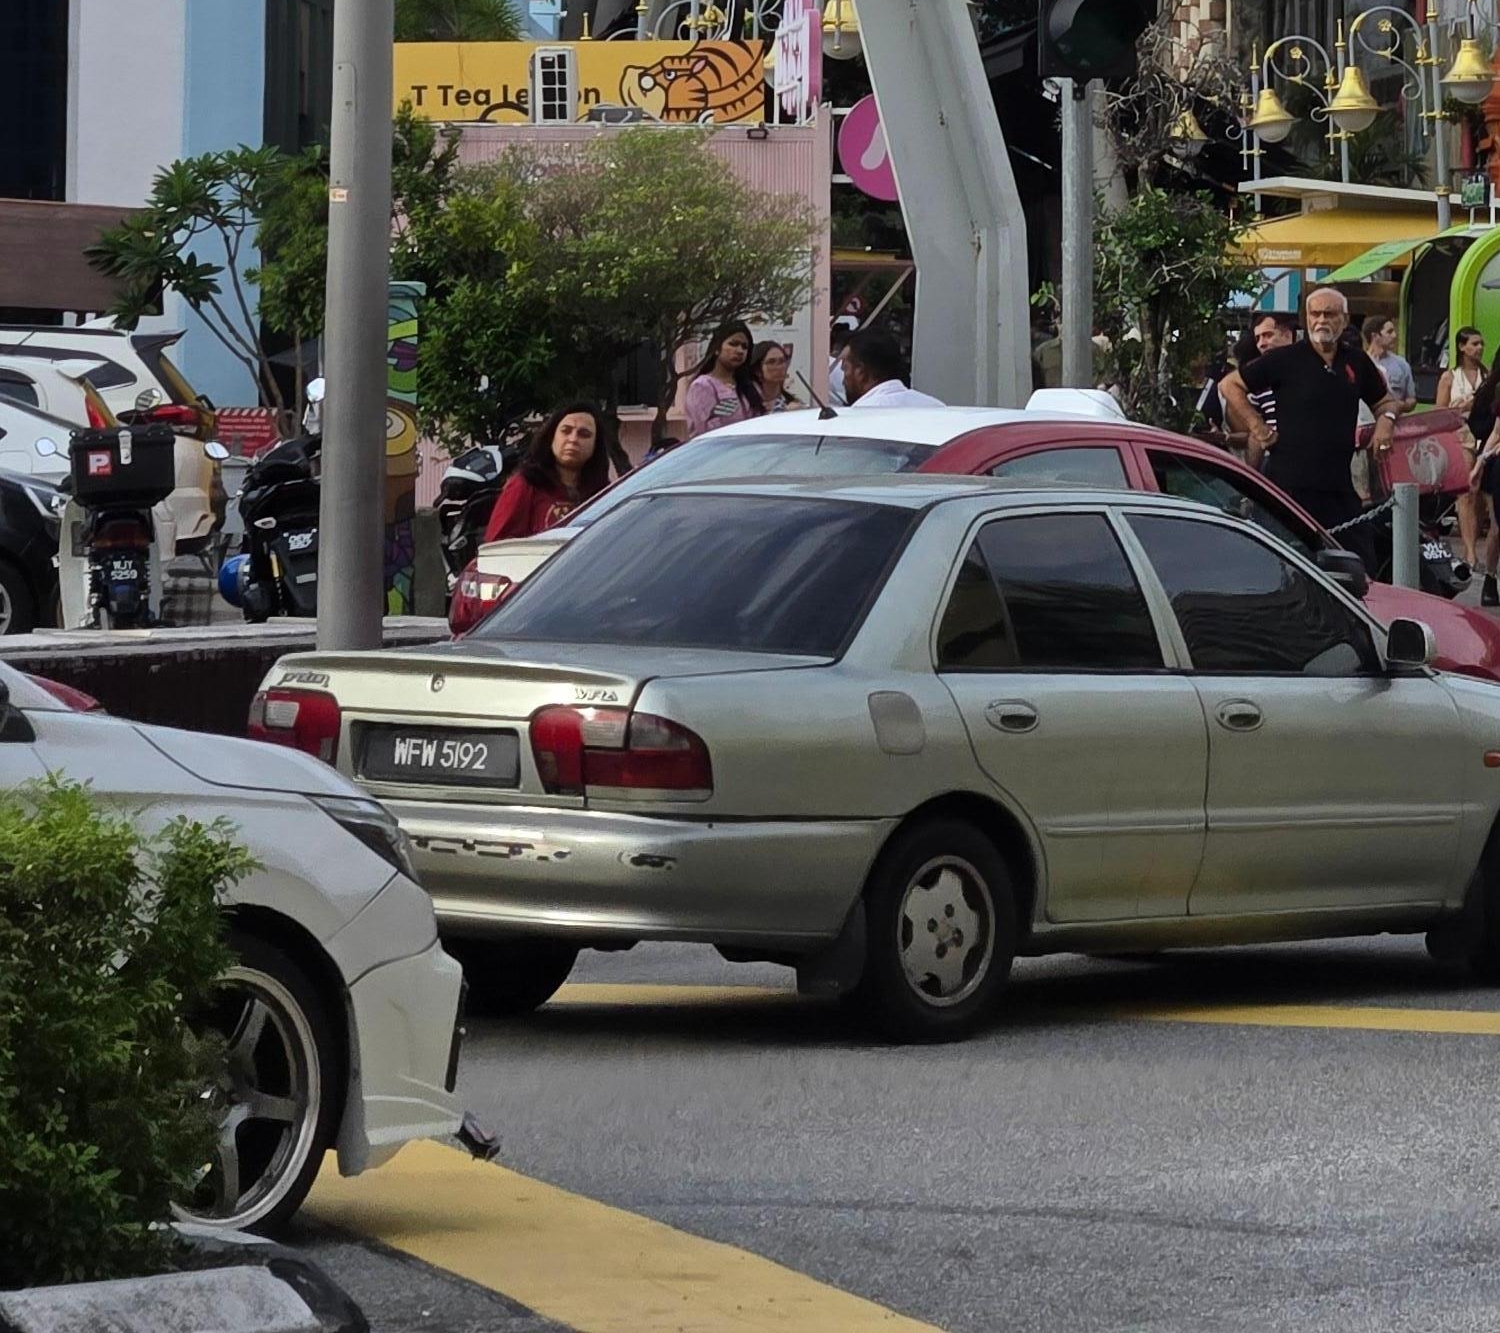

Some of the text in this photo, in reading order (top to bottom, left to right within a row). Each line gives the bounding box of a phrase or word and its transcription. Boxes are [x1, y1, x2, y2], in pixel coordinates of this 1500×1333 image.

[437, 85, 491, 106] Tea
[502, 85, 600, 106] Len
[394, 737, 488, 770] WFW 5192
